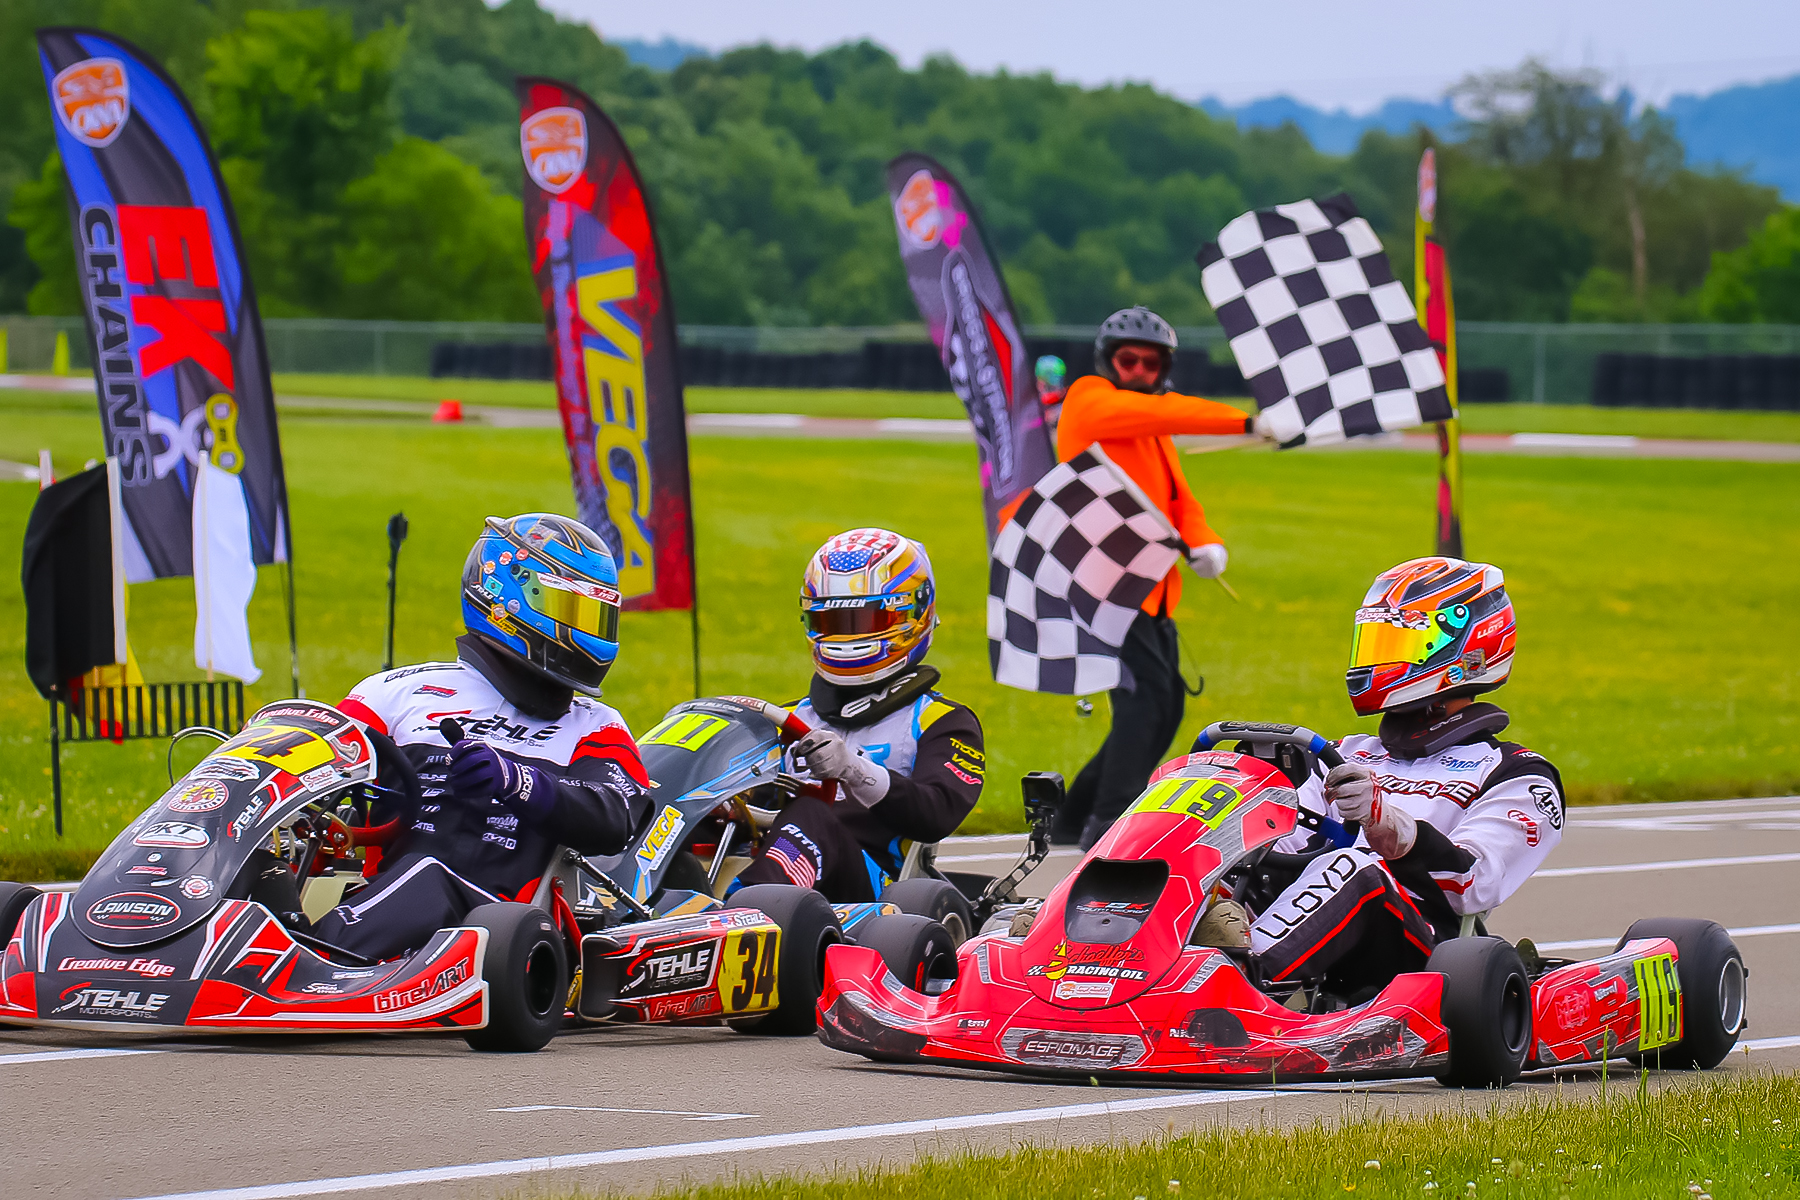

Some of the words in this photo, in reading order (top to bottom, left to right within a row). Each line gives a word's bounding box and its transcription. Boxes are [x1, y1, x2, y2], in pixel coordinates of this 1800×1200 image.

[116, 204, 235, 392] EK
[79, 204, 153, 488] CHAINS
[576, 266, 656, 601] VEGA
[823, 598, 867, 609] AITKEN
[1476, 619, 1505, 640] LLOYD
[304, 708, 341, 727] Edge
[638, 807, 682, 862] VEGA
[92, 901, 175, 917] LAWSON
[1255, 854, 1357, 939] LLOYD
[734, 911, 766, 927] STEHLE
[57, 956, 128, 972] Creative
[126, 957, 176, 977] Edge
[620, 948, 711, 994] STEHLE
[732, 929, 778, 1011] 34
[1066, 965, 1120, 977] RACING
[1120, 971, 1144, 980] OIL
[51, 981, 171, 1014] STEHLE
[373, 956, 470, 1013] birelART
[79, 1007, 152, 1019] MOTORSPORTS
[653, 992, 717, 1019] birelART
[1024, 1039, 1124, 1058] ESPIONAGE
